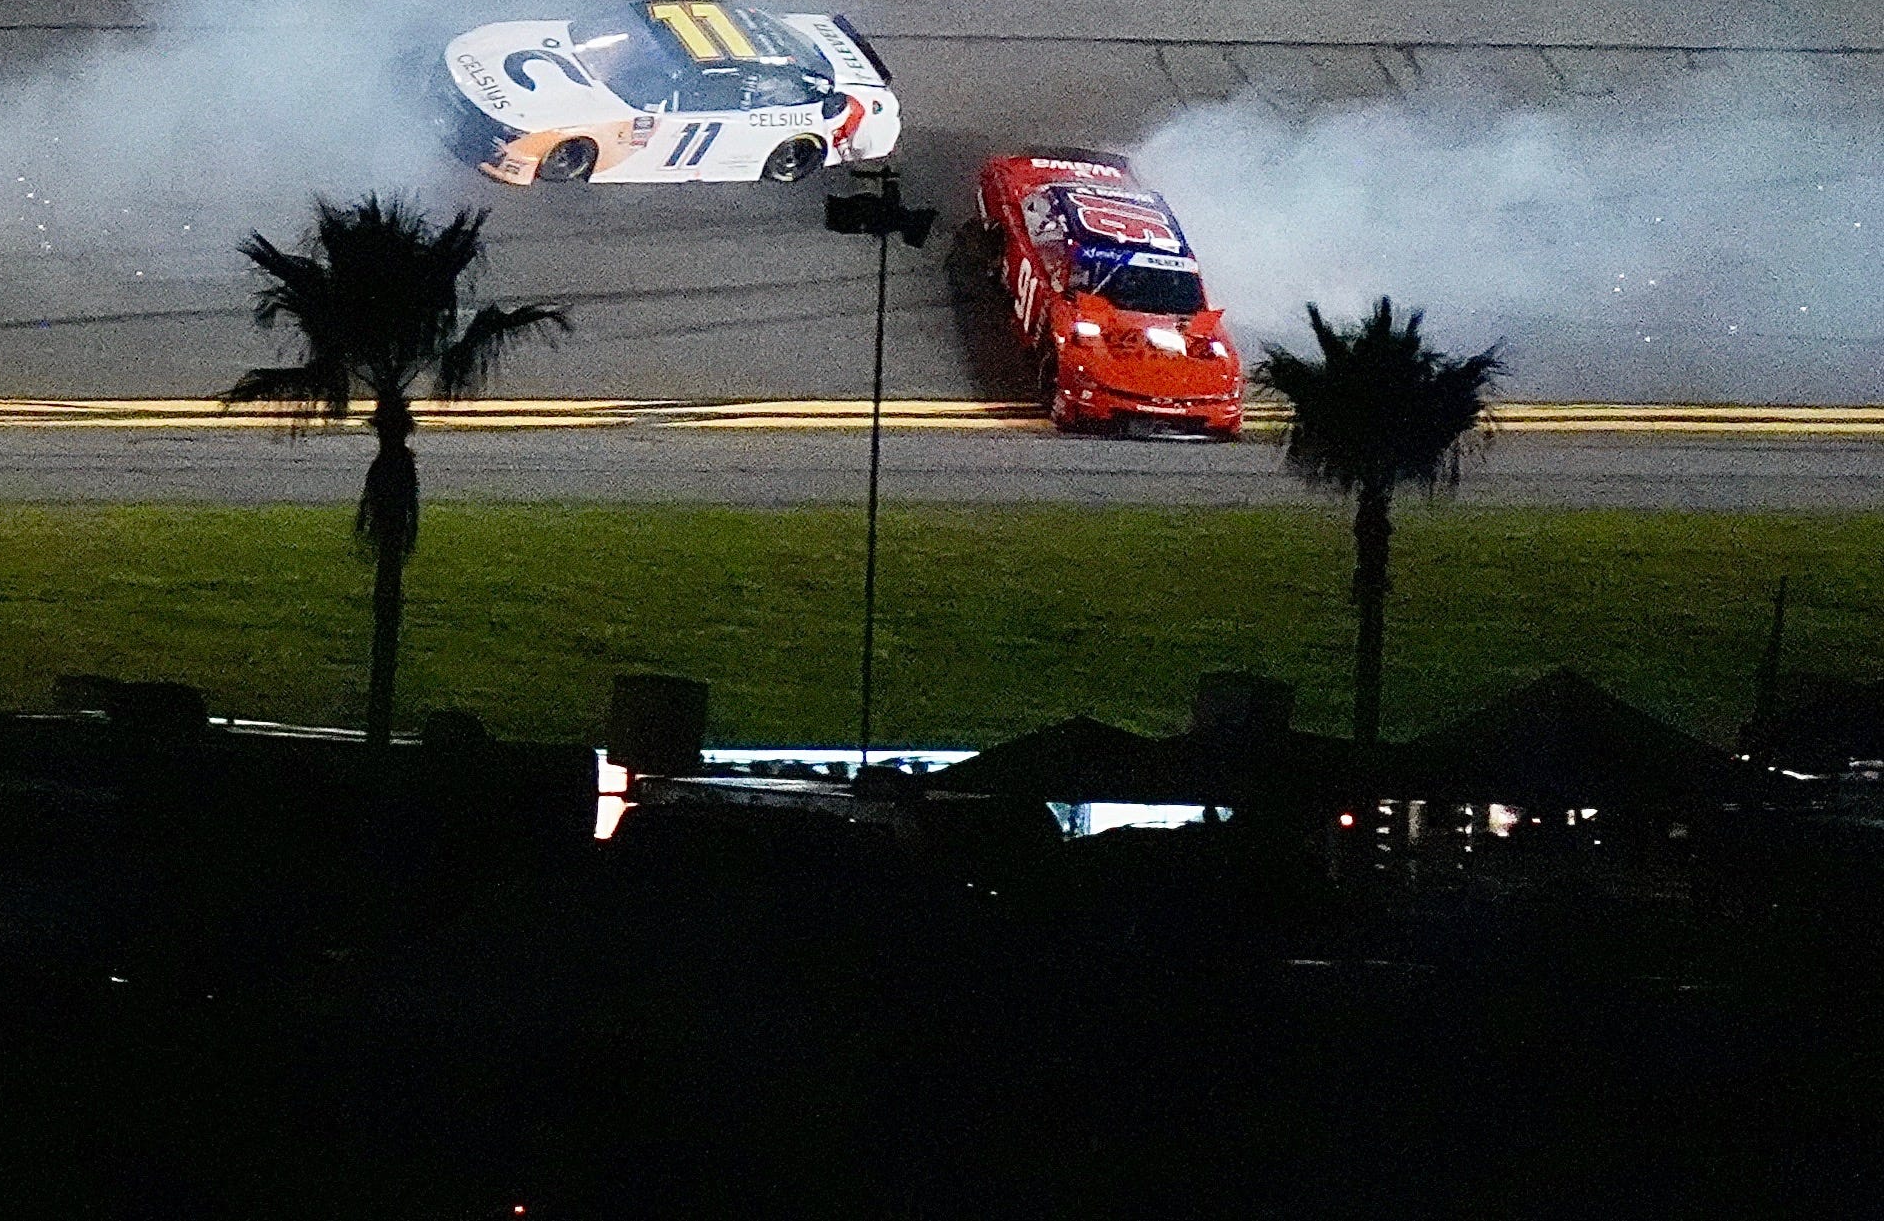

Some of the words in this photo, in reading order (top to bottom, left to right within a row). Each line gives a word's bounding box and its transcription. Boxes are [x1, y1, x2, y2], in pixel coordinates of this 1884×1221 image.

[653, 3, 757, 58] 11
[457, 53, 512, 110] CELSIUS
[664, 121, 724, 167] 11
[749, 112, 813, 127] CELSIUS
